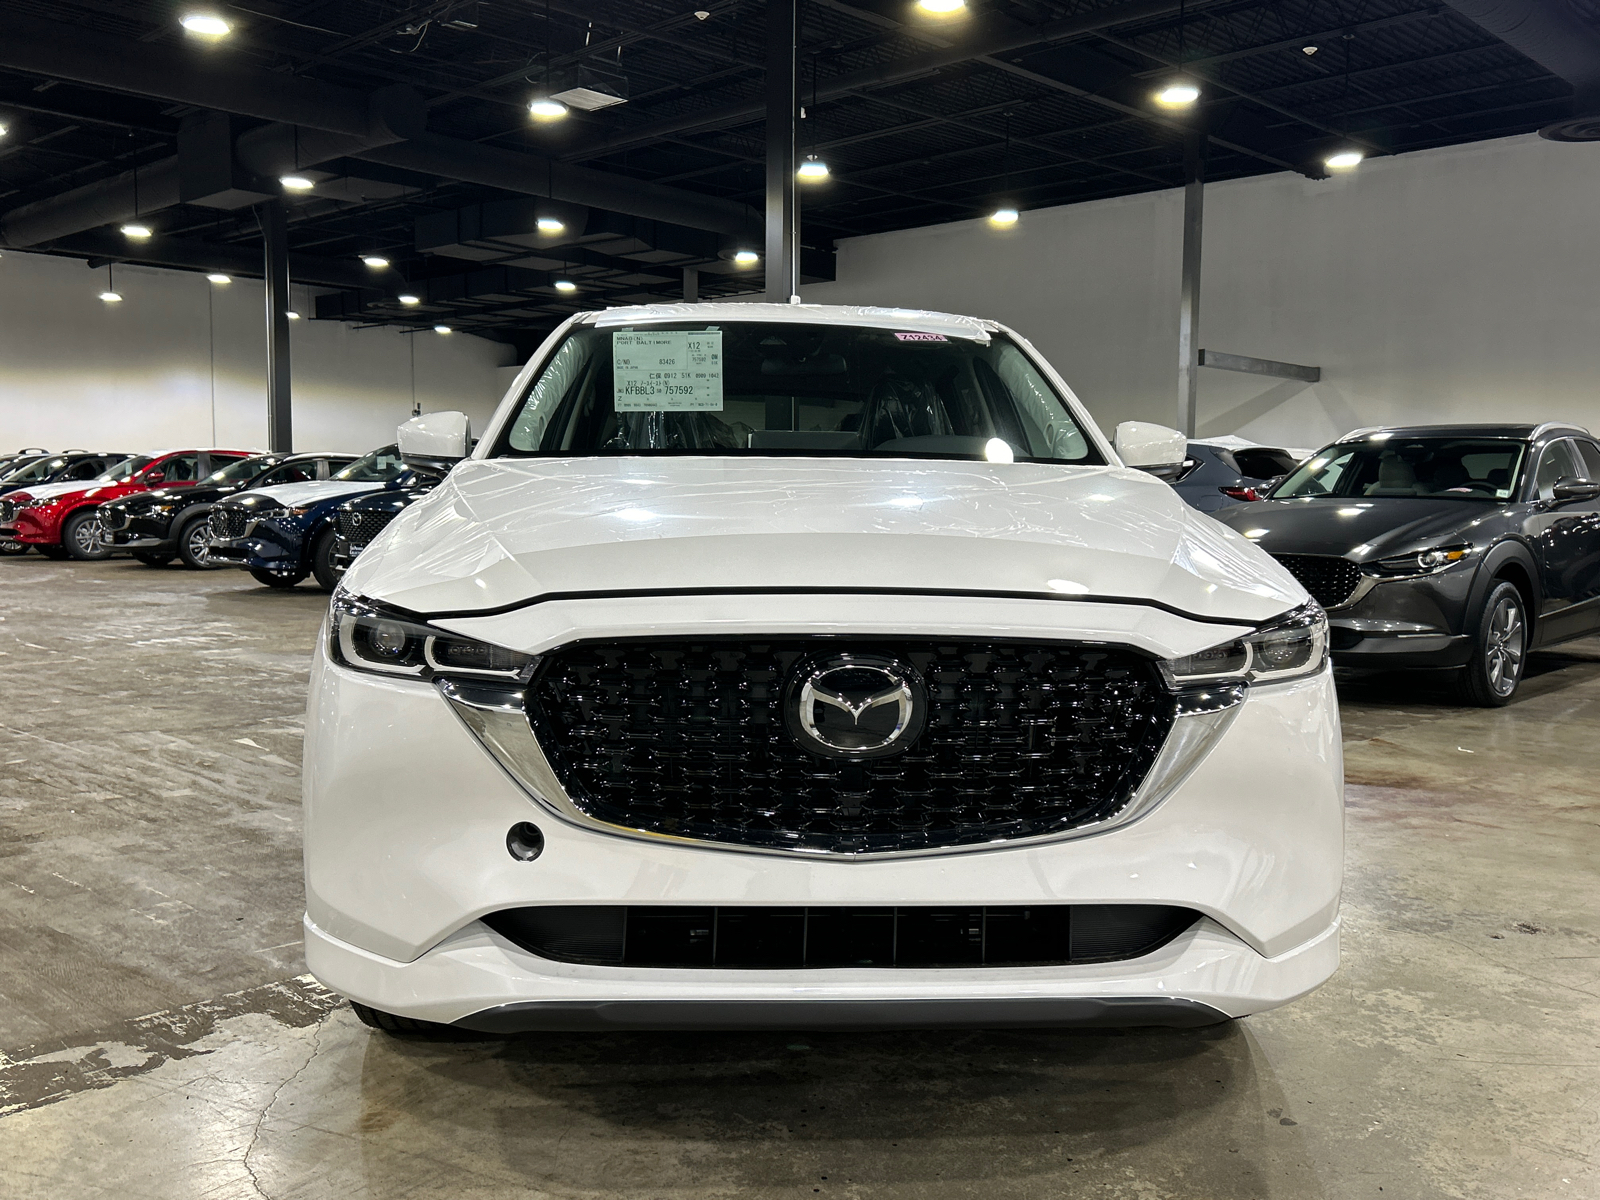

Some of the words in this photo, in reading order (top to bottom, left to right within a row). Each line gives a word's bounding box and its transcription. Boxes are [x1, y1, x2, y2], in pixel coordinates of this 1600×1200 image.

[687, 341, 701, 350] X12
[625, 386, 655, 395] KFBBL3
[664, 386, 694, 395] 757592
